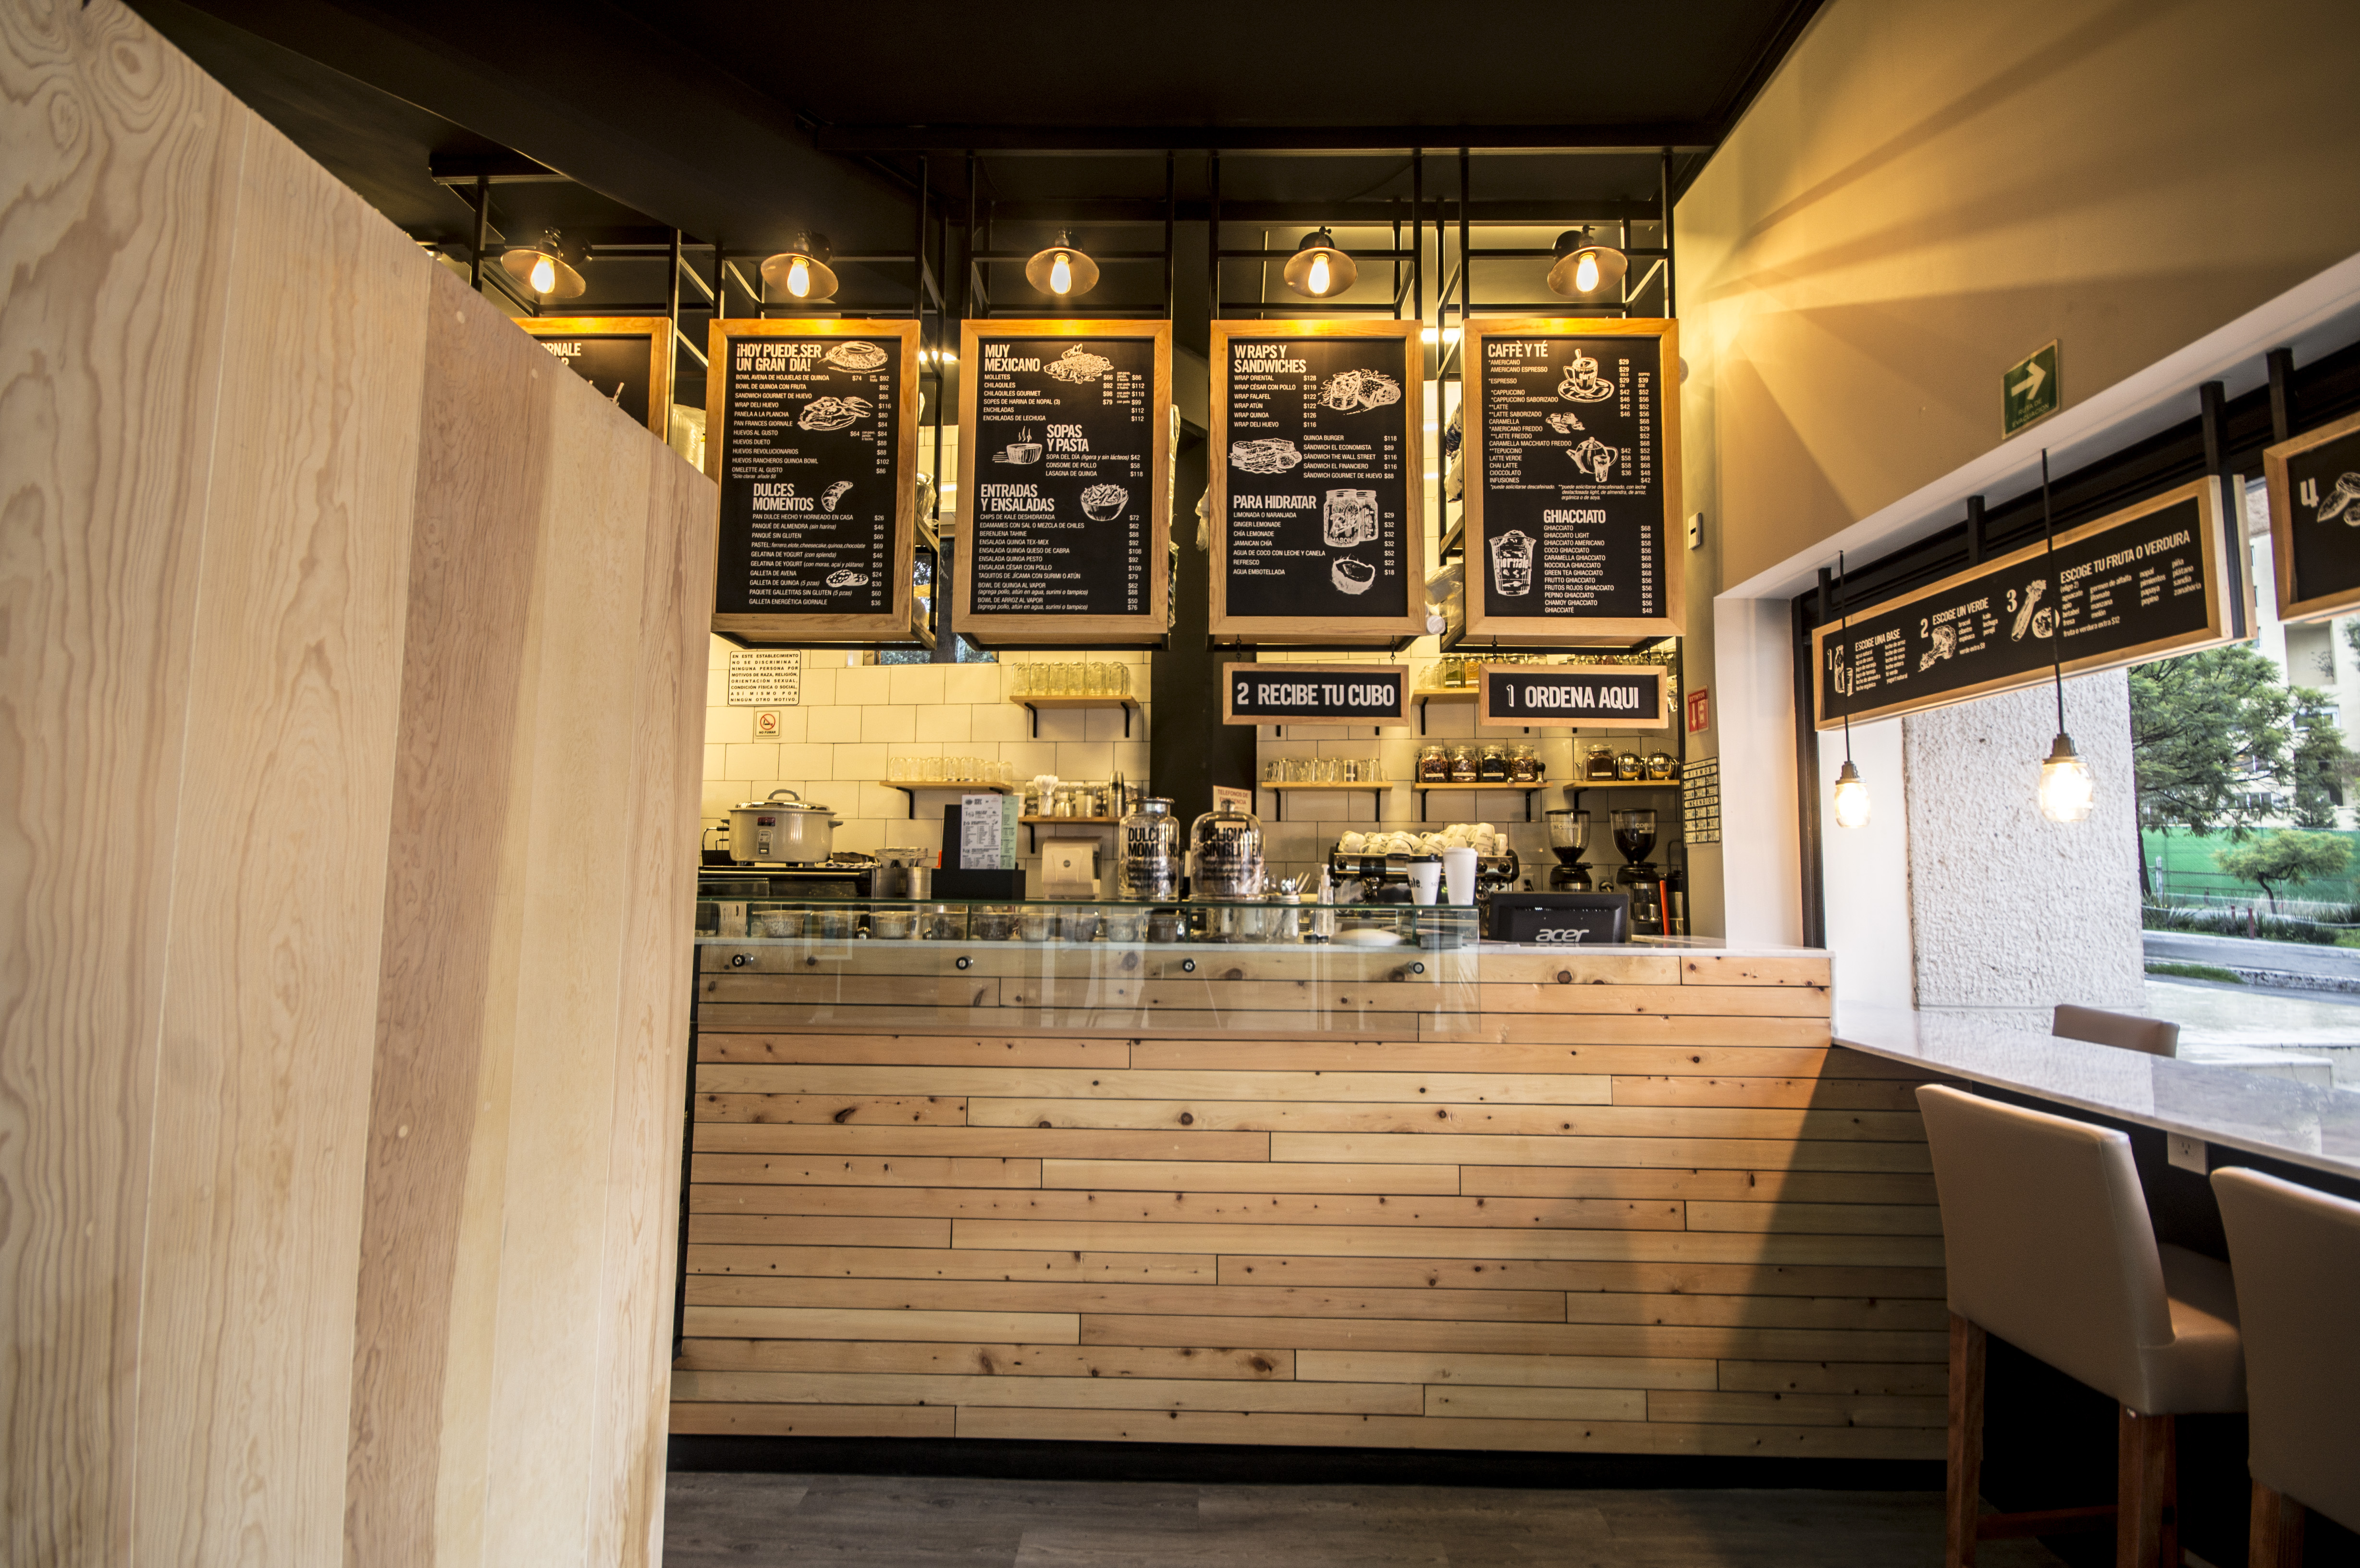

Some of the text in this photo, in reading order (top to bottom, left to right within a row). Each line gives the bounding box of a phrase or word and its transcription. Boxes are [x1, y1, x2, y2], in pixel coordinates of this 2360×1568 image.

[763, 343, 799, 359] PUEDE
[799, 343, 822, 359] SER
[985, 344, 1010, 357] MUY
[1235, 344, 1287, 358] WRAPS Y
[1488, 340, 1549, 357] CAFFÈ Y TÉ
[737, 354, 811, 371] UN GRAN DÍA!
[985, 357, 1040, 372] MEXICANO
[1234, 358, 1306, 373] SANDWICHES
[1047, 425, 1082, 438] SOPAS
[1047, 439, 1089, 452] Y PASTA
[754, 483, 794, 498] DULCES
[981, 484, 1037, 499] ENTRADAS
[2300, 478, 2319, 508] 4
[753, 497, 813, 511] MOMENTOS
[981, 498, 1054, 511] Y ENSALADAS
[1234, 495, 1316, 509] PARA HIDRATAR
[1544, 510, 1606, 523] GHIACCIATO
[2061, 530, 2190, 584] ESCOGE TU FRUTA O VERDURA
[2007, 589, 2017, 612] 3
[1921, 597, 1989, 638] 2 ESCOGE UN VERDE
[1827, 628, 1900, 670] 1 ESCOGE UNA BASE
[1238, 683, 1394, 706] 2 RECIBE TU CUBO
[1507, 685, 1638, 710] 1 ORDENA AQUI
[1688, 768, 1711, 777] SISMOS
[1687, 797, 1714, 807] INCENDIOS
[1536, 928, 1589, 942] acer
